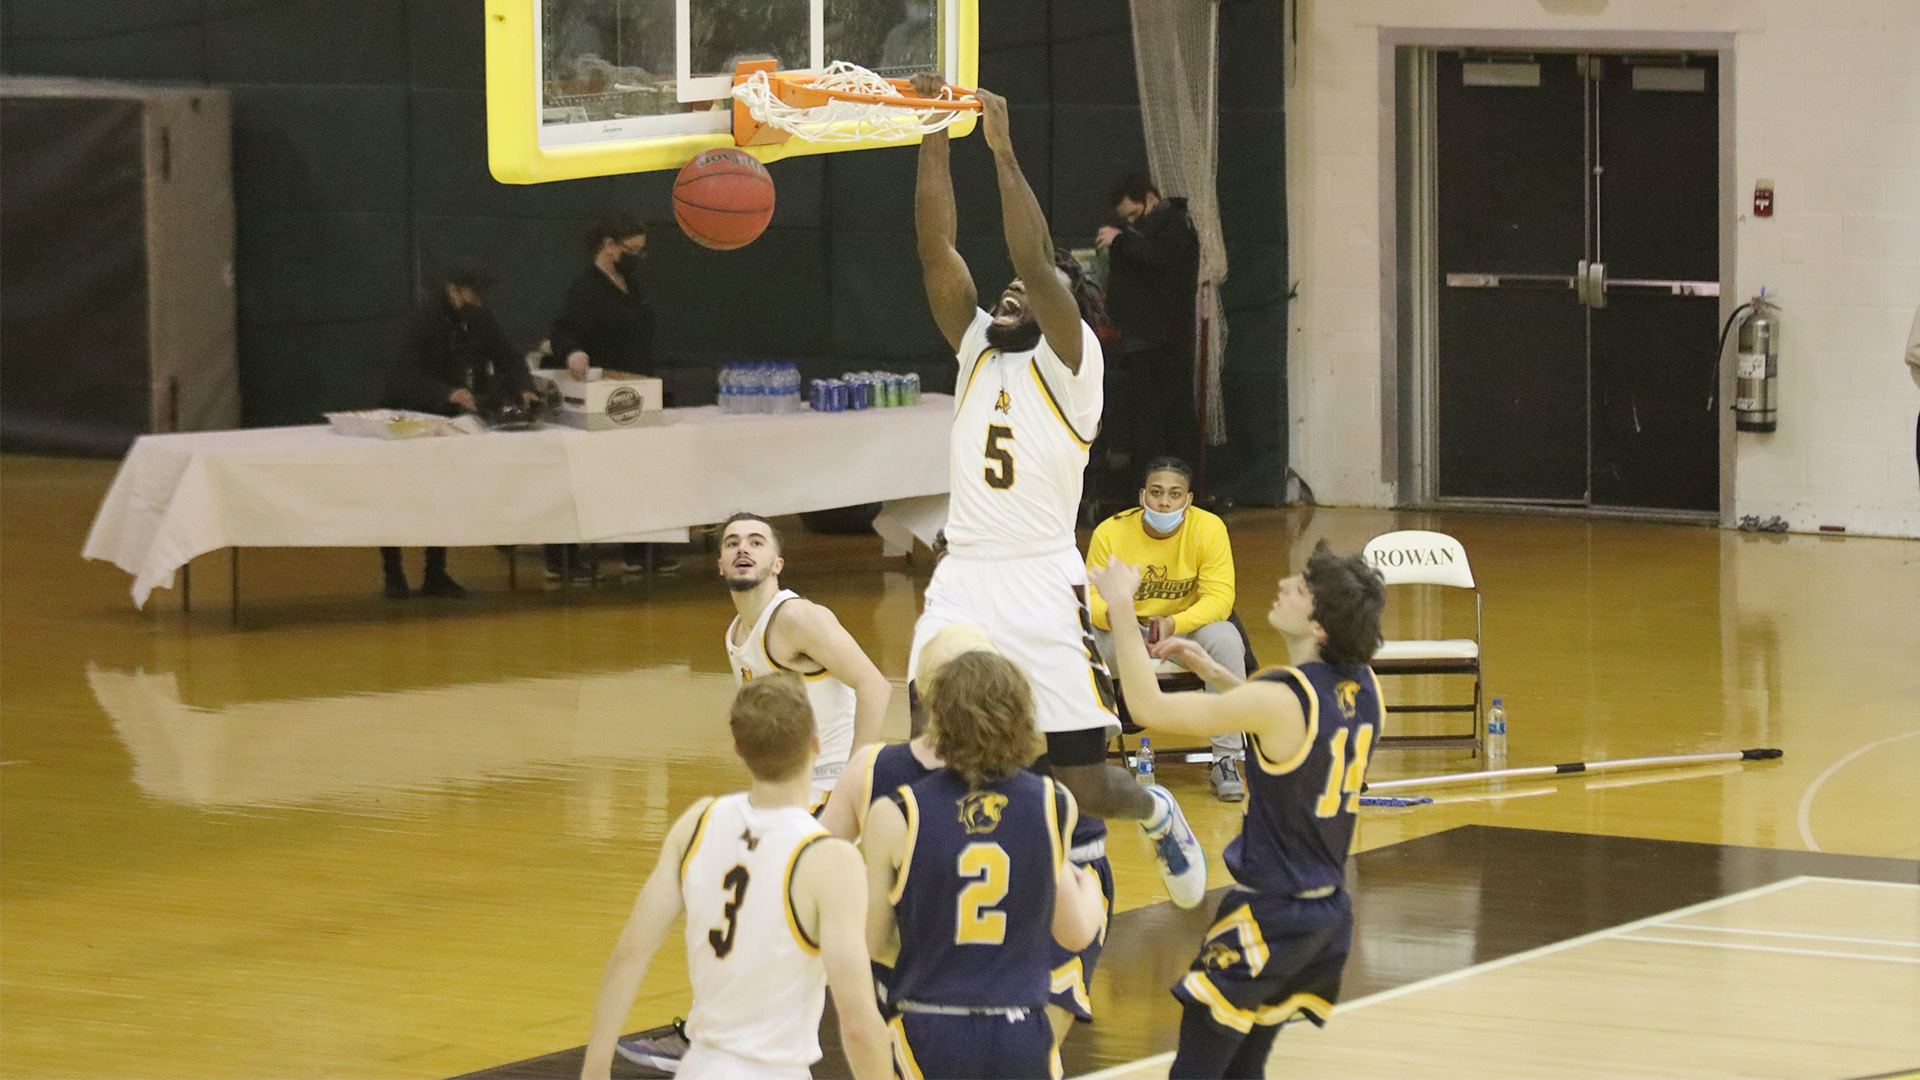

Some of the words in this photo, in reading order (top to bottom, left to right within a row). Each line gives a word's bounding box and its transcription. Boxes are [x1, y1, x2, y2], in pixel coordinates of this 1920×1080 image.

[983, 422, 1016, 491] 5
[1373, 547, 1455, 568] ROWAN
[1315, 723, 1374, 818] 14
[708, 863, 751, 960] 3
[955, 842, 1011, 946] 2
